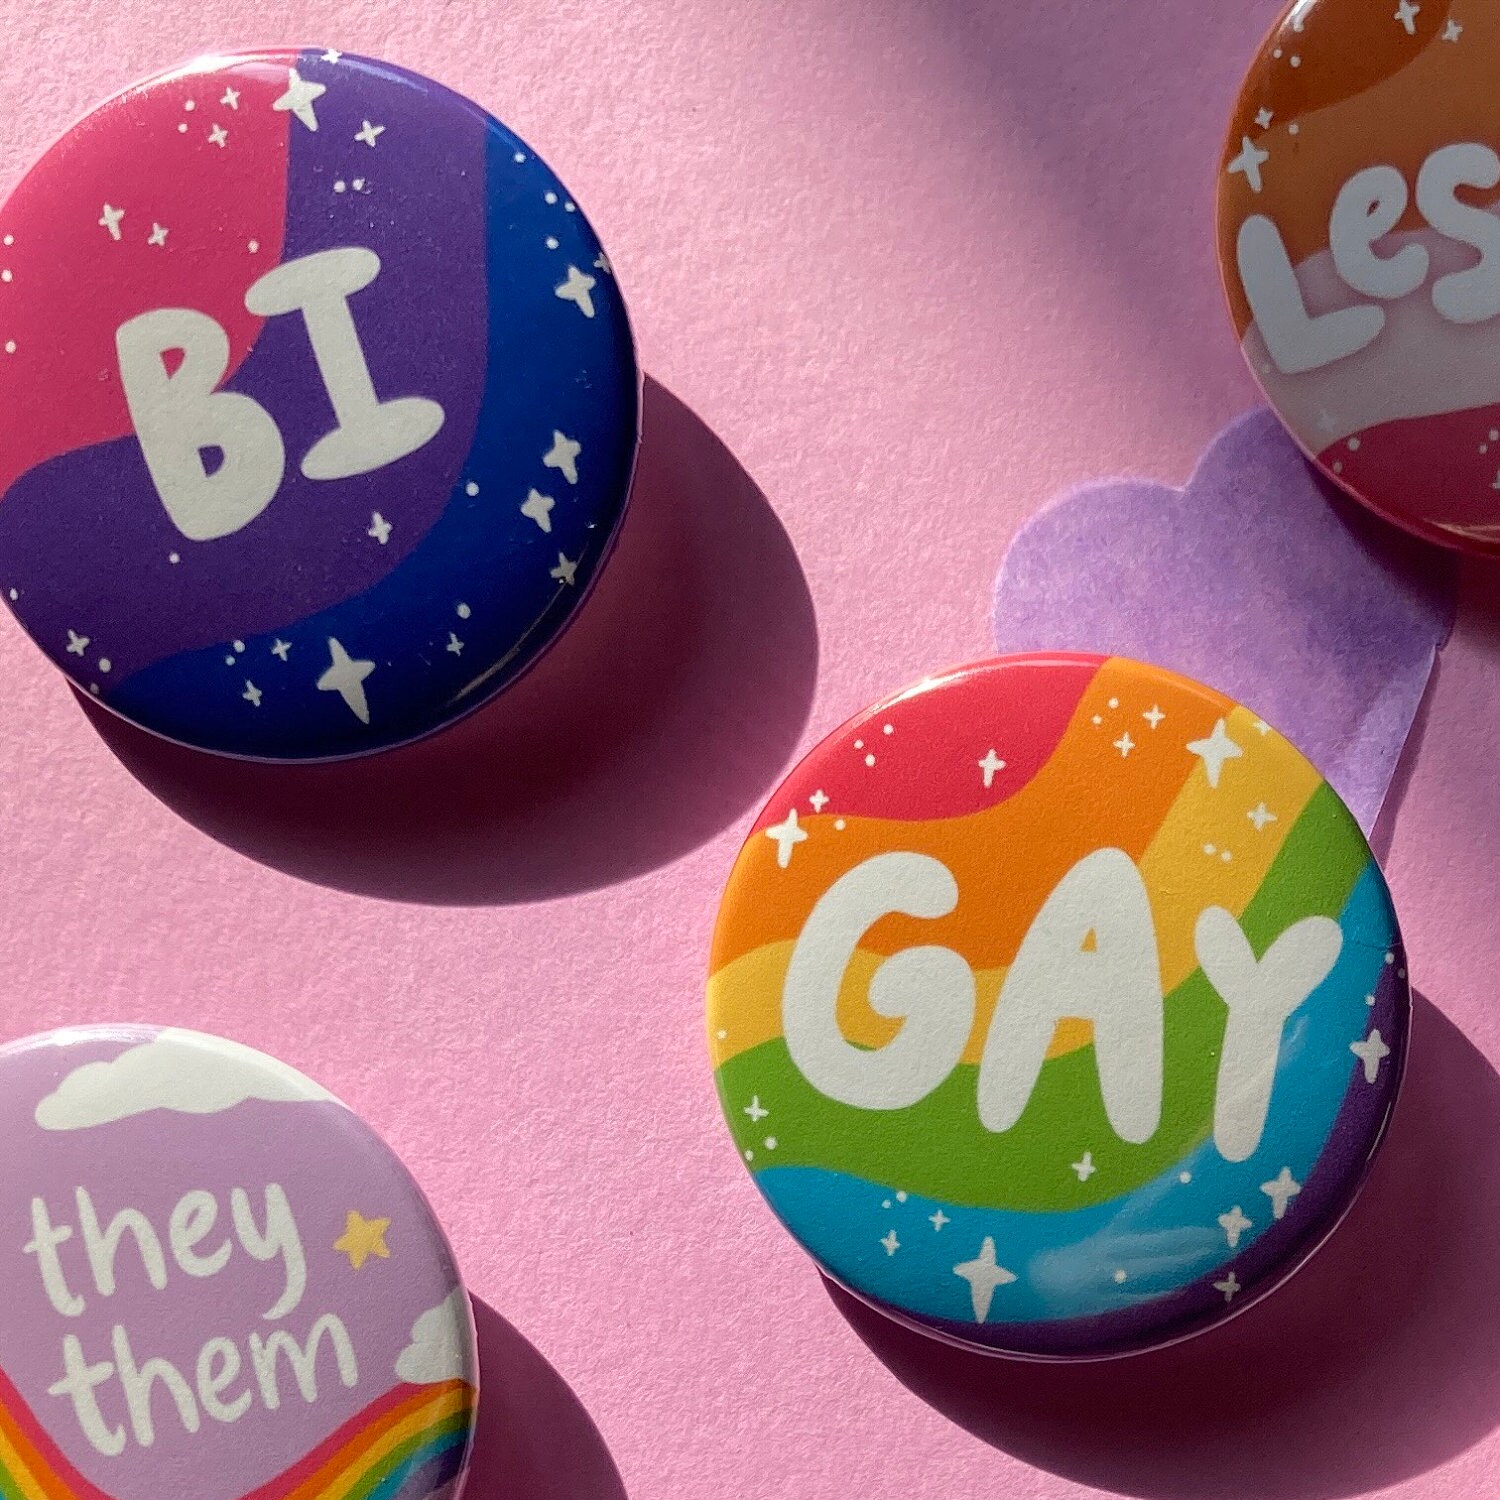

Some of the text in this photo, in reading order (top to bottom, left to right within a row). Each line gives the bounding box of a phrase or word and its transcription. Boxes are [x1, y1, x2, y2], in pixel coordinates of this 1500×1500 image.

[116, 247, 445, 541] BI
[783, 848, 1343, 1162] GAY
[23, 1183, 307, 1320] they
[49, 1312, 358, 1457] them
